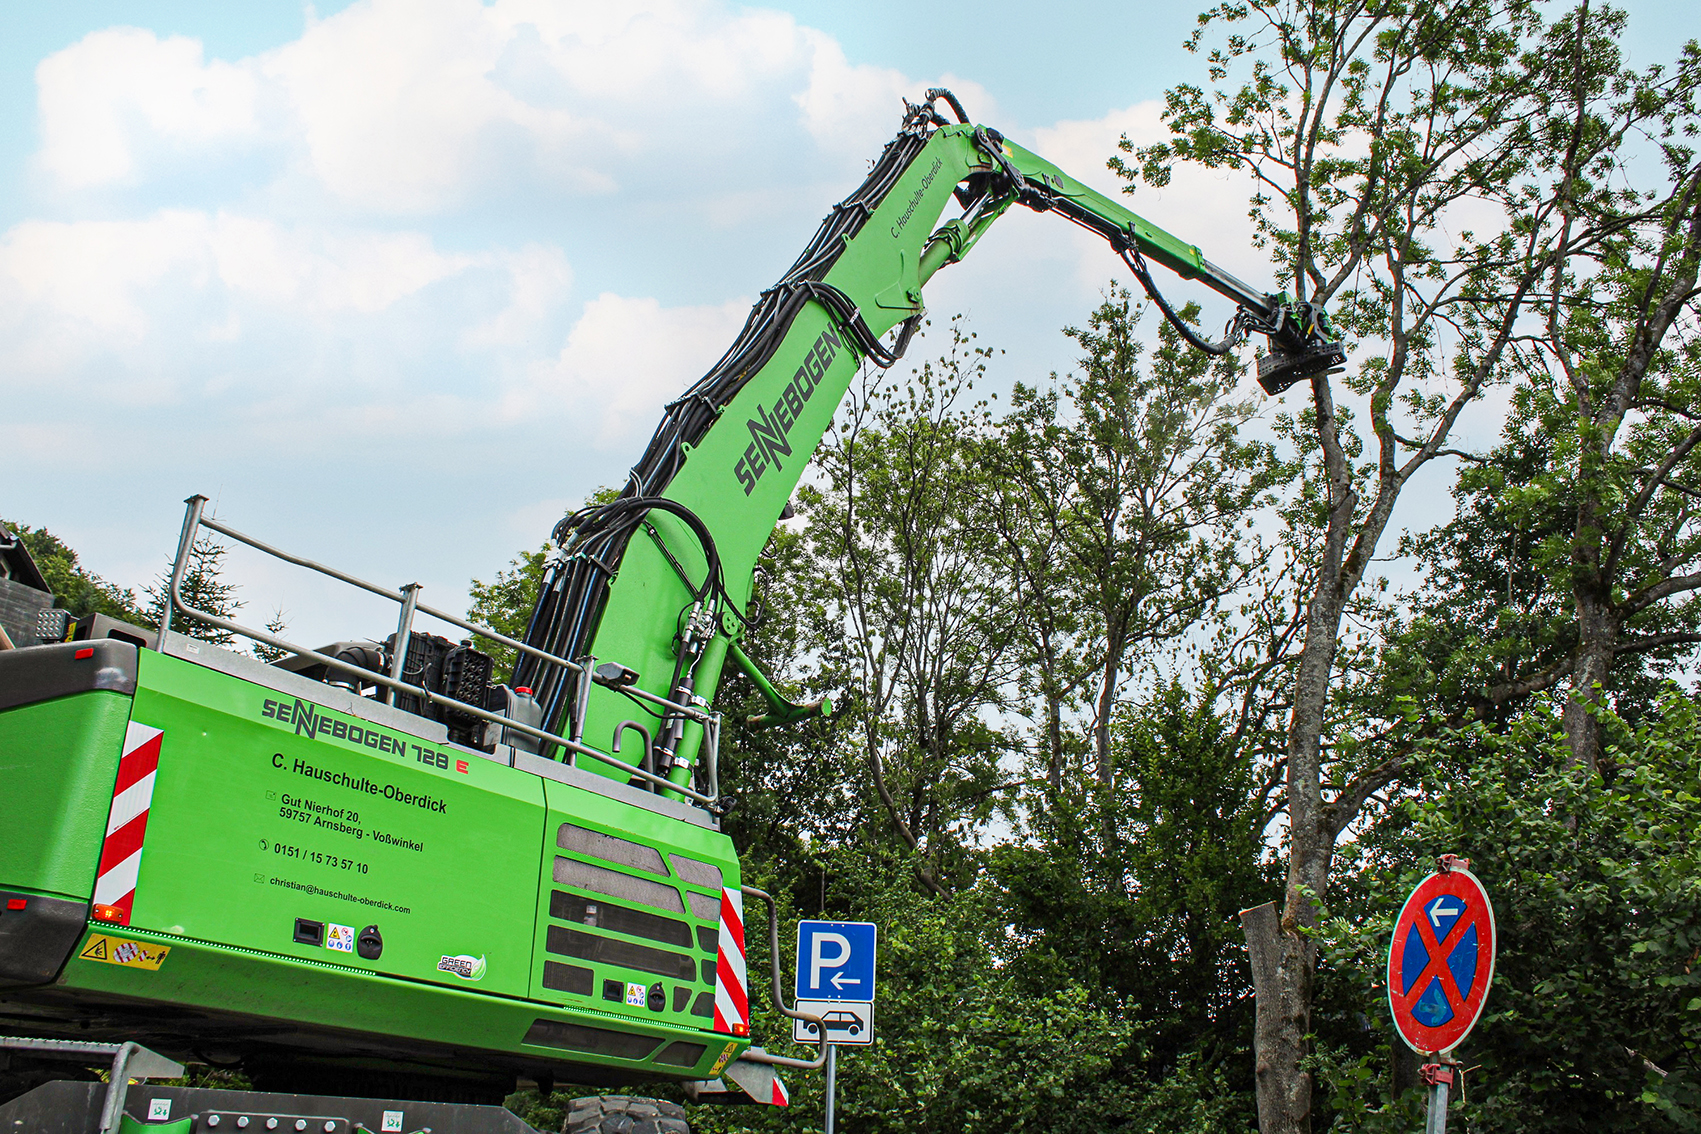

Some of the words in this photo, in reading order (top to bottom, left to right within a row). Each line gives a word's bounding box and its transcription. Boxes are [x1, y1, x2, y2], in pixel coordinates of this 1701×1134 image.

[896, 156, 943, 230] Hauschulte-Oberdick
[734, 321, 843, 497] SENNEBOGEN
[262, 698, 406, 757] SENNEBOGEN
[412, 745, 449, 770] 728
[456, 760, 469, 774] E
[272, 753, 287, 770] C.
[293, 758, 447, 814] Hauschulte-Oberdick
[281, 794, 301, 808] Gut
[304, 800, 344, 819] Nierhof
[347, 811, 361, 825] 20,
[279, 807, 311, 824] 59757
[313, 816, 363, 839] Arnsberg
[373, 830, 423, 852] Voßwinkel
[274, 843, 300, 859] 0151
[310, 851, 322, 864] 15
[326, 854, 338, 867] 73
[341, 858, 353, 870] 57
[357, 862, 369, 874] 10
[270, 876, 411, 914] christian@hauschulte-oberdick.com
[810, 932, 851, 989] P
